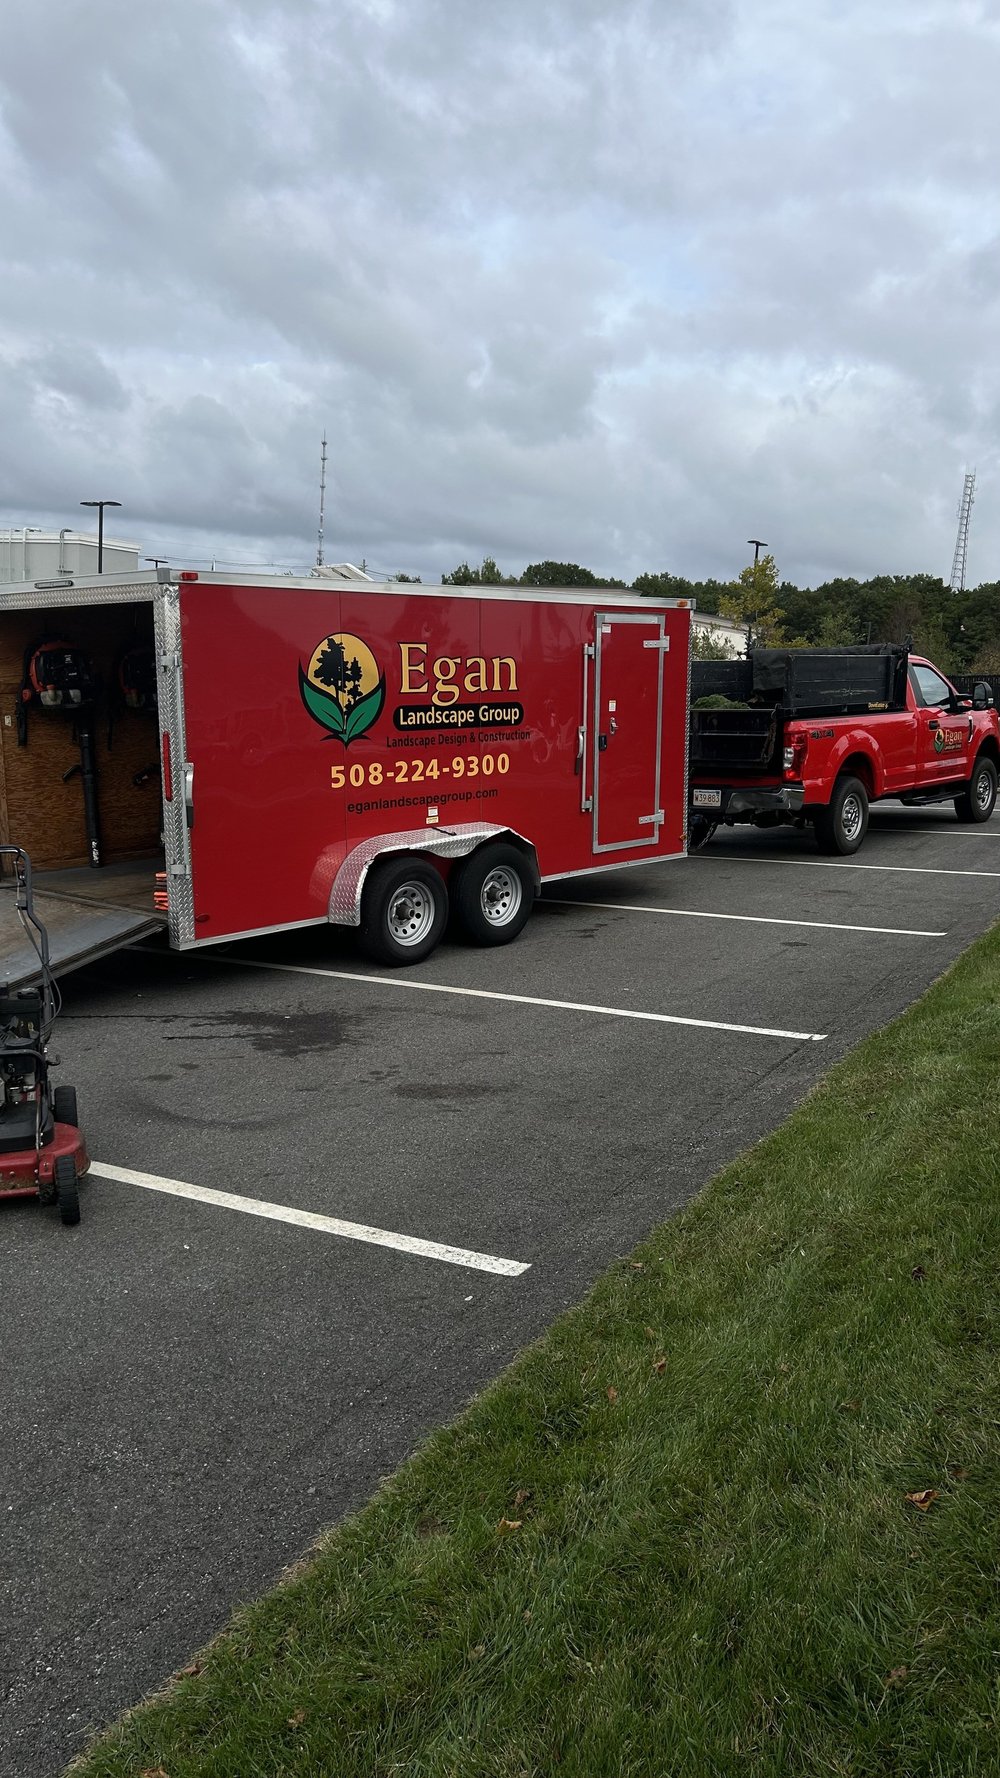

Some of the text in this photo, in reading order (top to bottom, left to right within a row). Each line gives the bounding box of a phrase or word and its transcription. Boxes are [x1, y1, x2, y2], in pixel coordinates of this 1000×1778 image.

[399, 642, 518, 706] Egan
[400, 705, 520, 726] Landscape Group
[386, 730, 531, 748] Landscape Design & Construction
[945, 729, 963, 745] Egan
[330, 753, 510, 788] 508-224-9300
[347, 789, 498, 815] eganlandscapegroup.com
